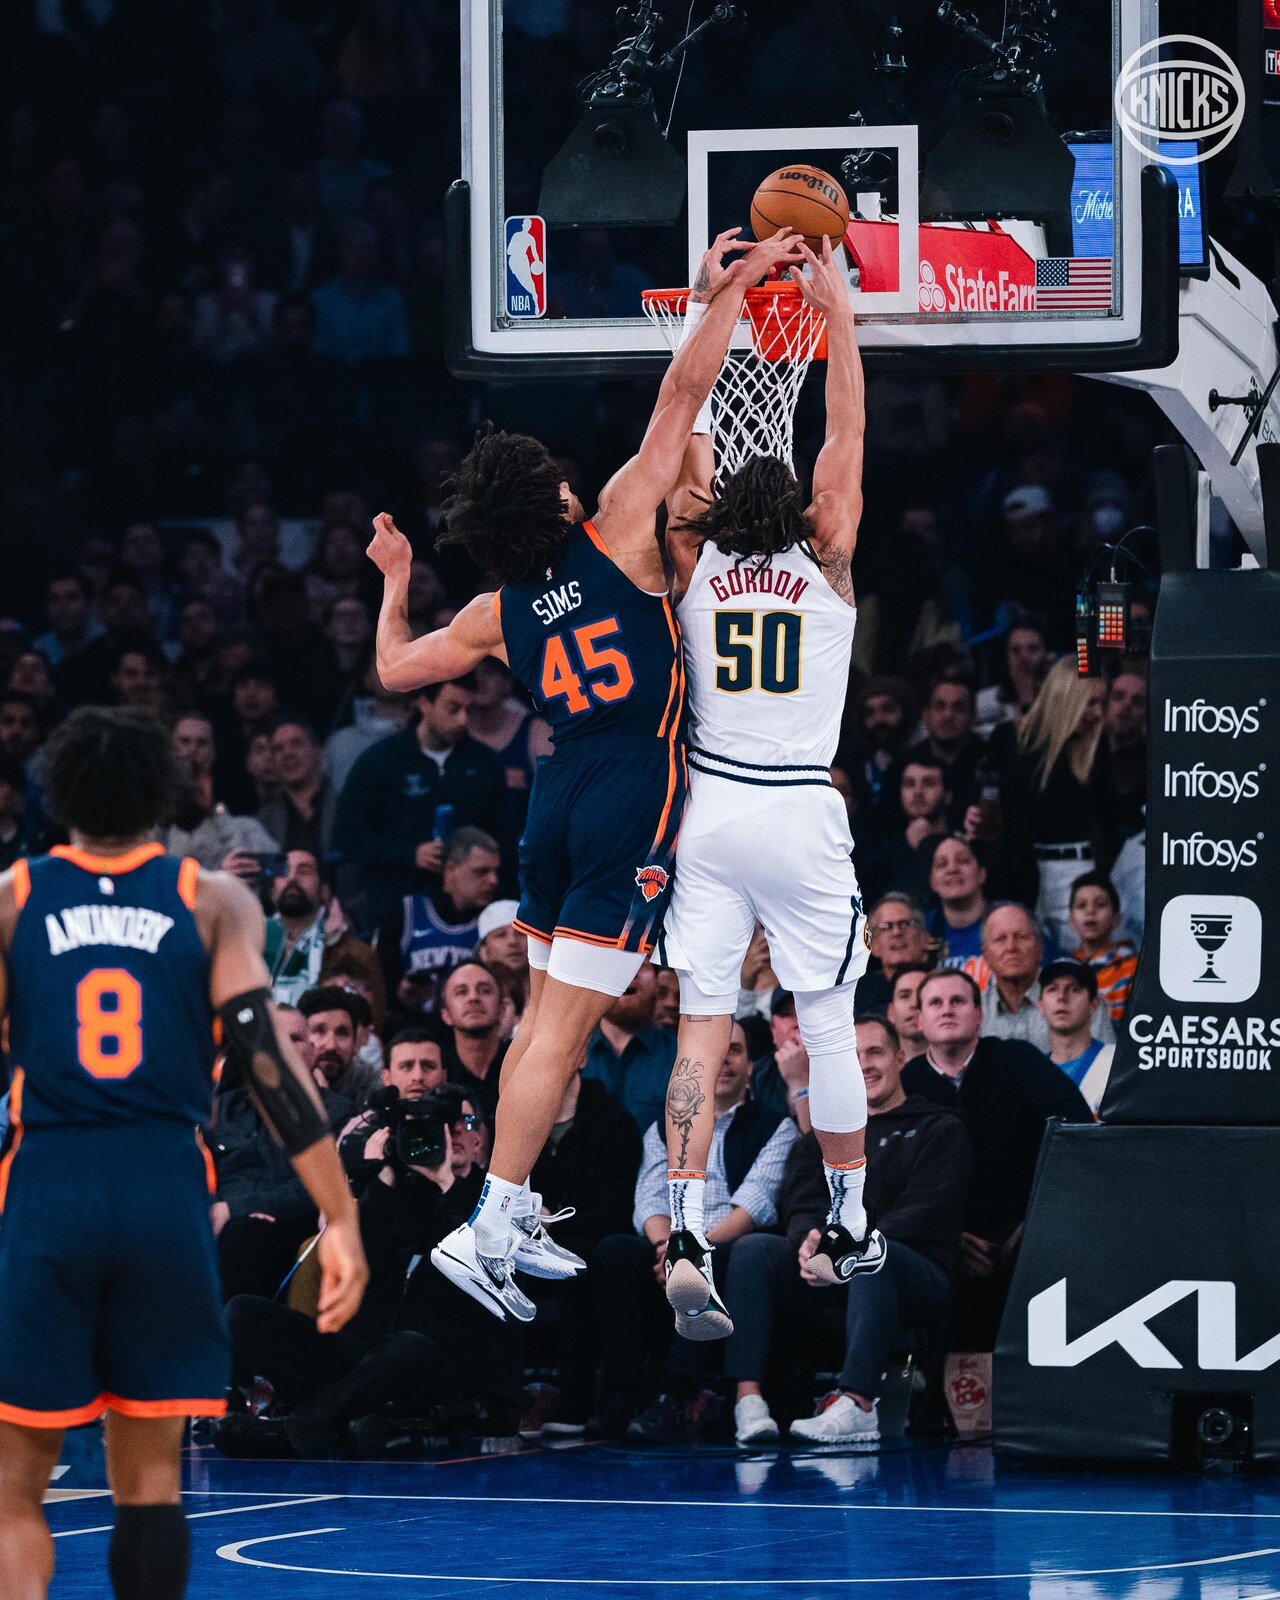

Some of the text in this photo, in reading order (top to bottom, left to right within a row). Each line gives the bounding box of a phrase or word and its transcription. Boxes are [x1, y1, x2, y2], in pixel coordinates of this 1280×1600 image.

[779, 172, 839, 206] Wilson
[511, 295, 531, 312] NBA
[945, 263, 998, 311] State
[532, 580, 582, 625] SIMS
[709, 567, 810, 605] GORDON
[539, 613, 637, 718] 45
[713, 608, 804, 697] 50
[1164, 698, 1260, 739] Infosys
[1164, 762, 1260, 804] Infosys
[1162, 832, 1258, 872] Infosys
[45, 904, 175, 956] ANUNOBY
[76, 967, 142, 1079] 8
[1138, 1045, 1272, 1071] SPORTSBOOK
